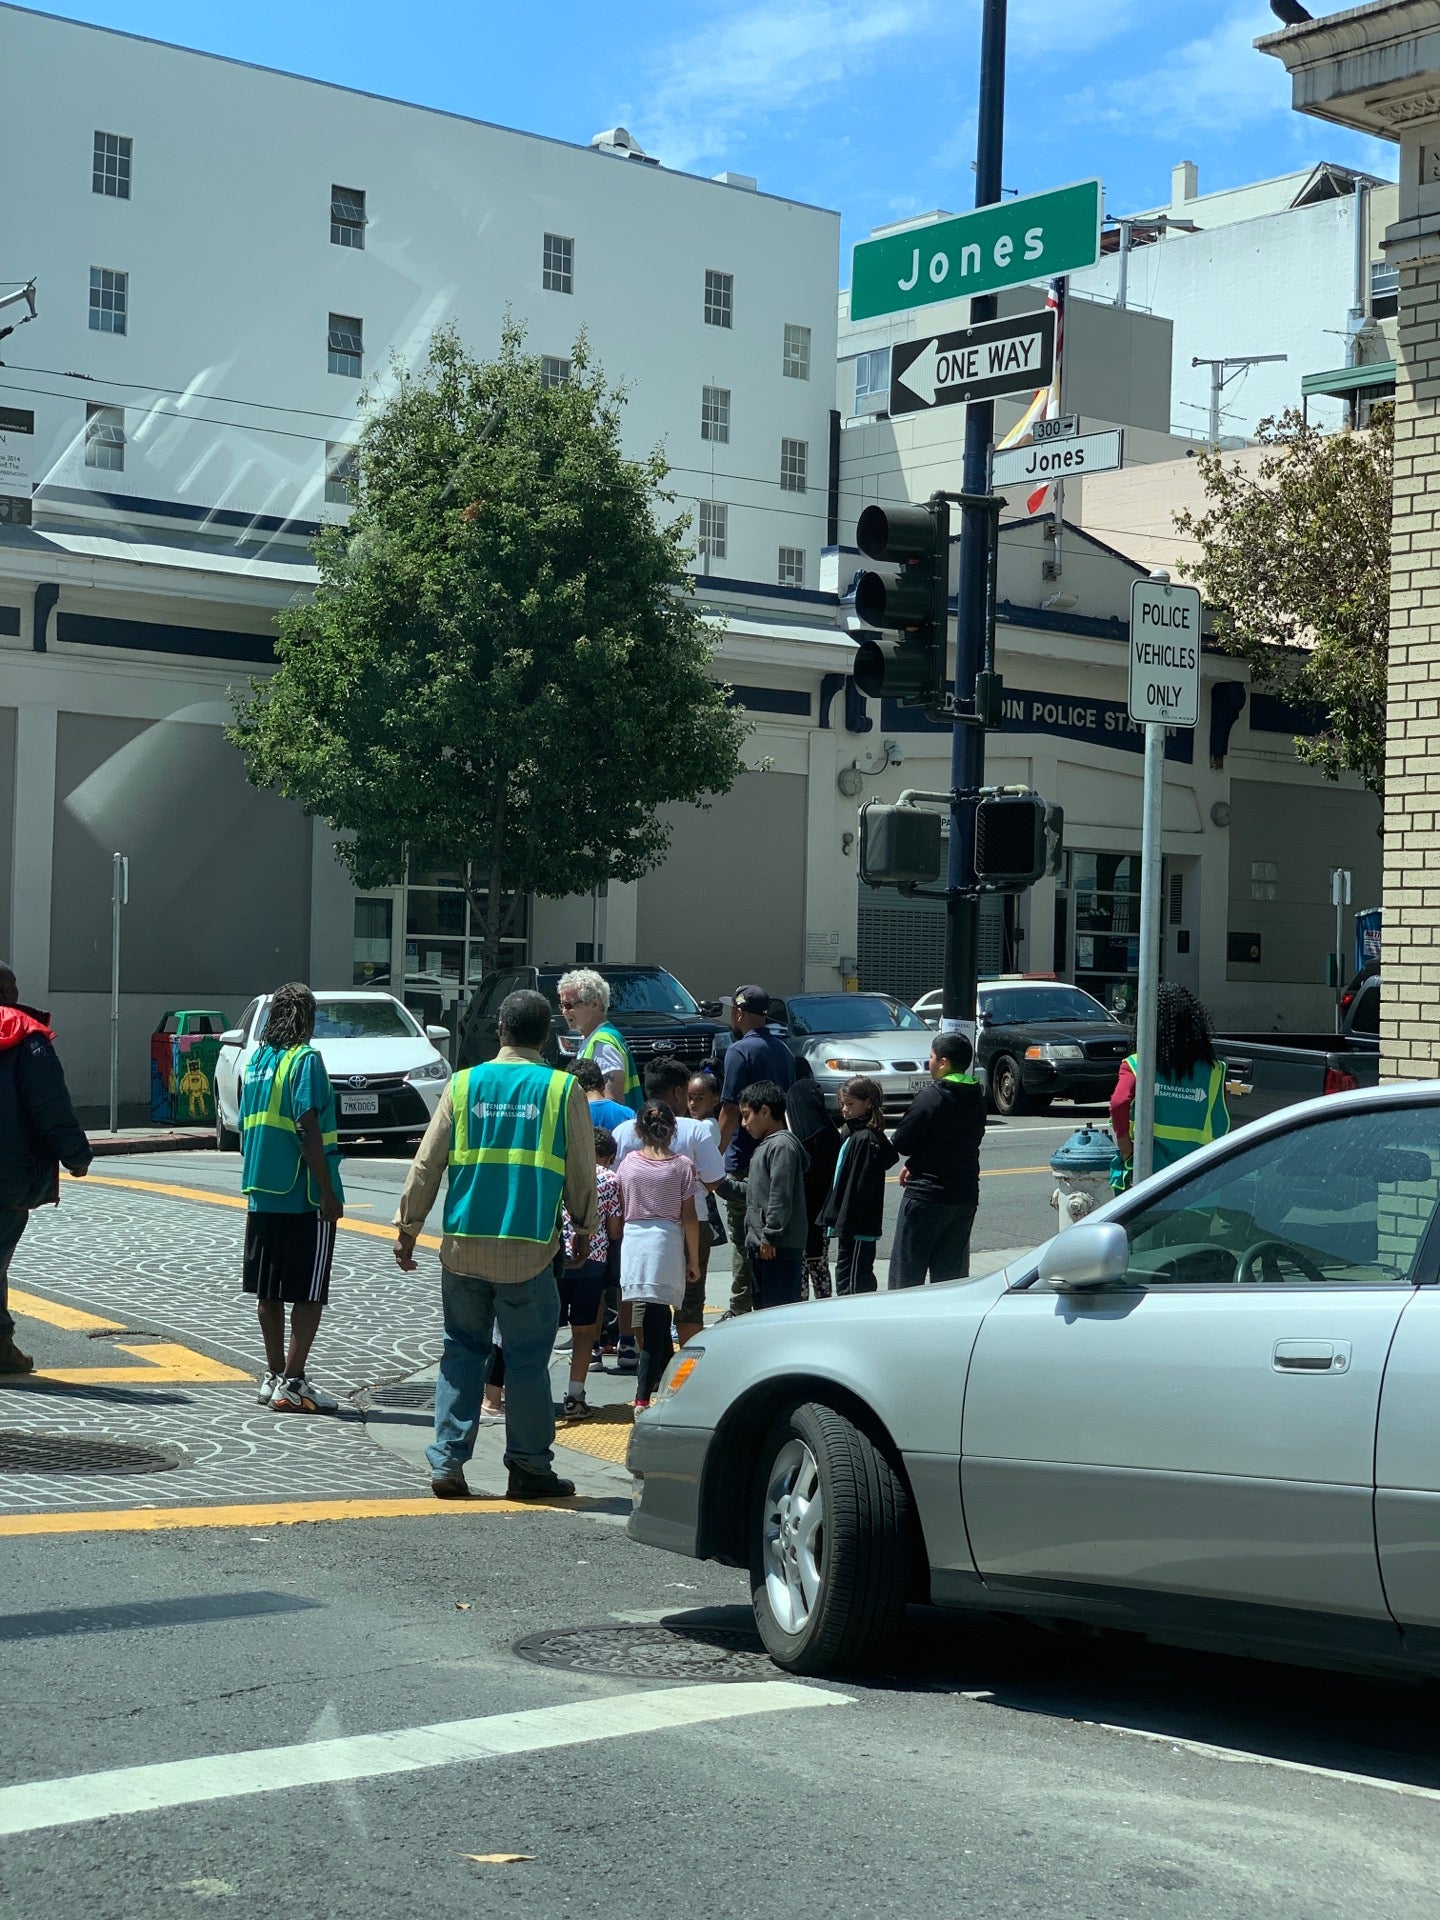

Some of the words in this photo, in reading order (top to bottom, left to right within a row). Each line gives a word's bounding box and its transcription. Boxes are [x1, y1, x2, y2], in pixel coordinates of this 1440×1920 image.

[897, 227, 1044, 291] Jones
[936, 349, 979, 384] ONE
[988, 337, 1036, 372] WAY
[1038, 421, 1060, 438] 300
[1025, 448, 1085, 474] Jones
[1142, 603, 1190, 629] POLICE
[1135, 642, 1195, 669] VEHICLES
[1147, 683, 1182, 708] ONLY
[1032, 702, 1096, 729] POLICE
[1104, 711, 1177, 737] STAN
[485, 1102, 526, 1111] TENDERLOIN
